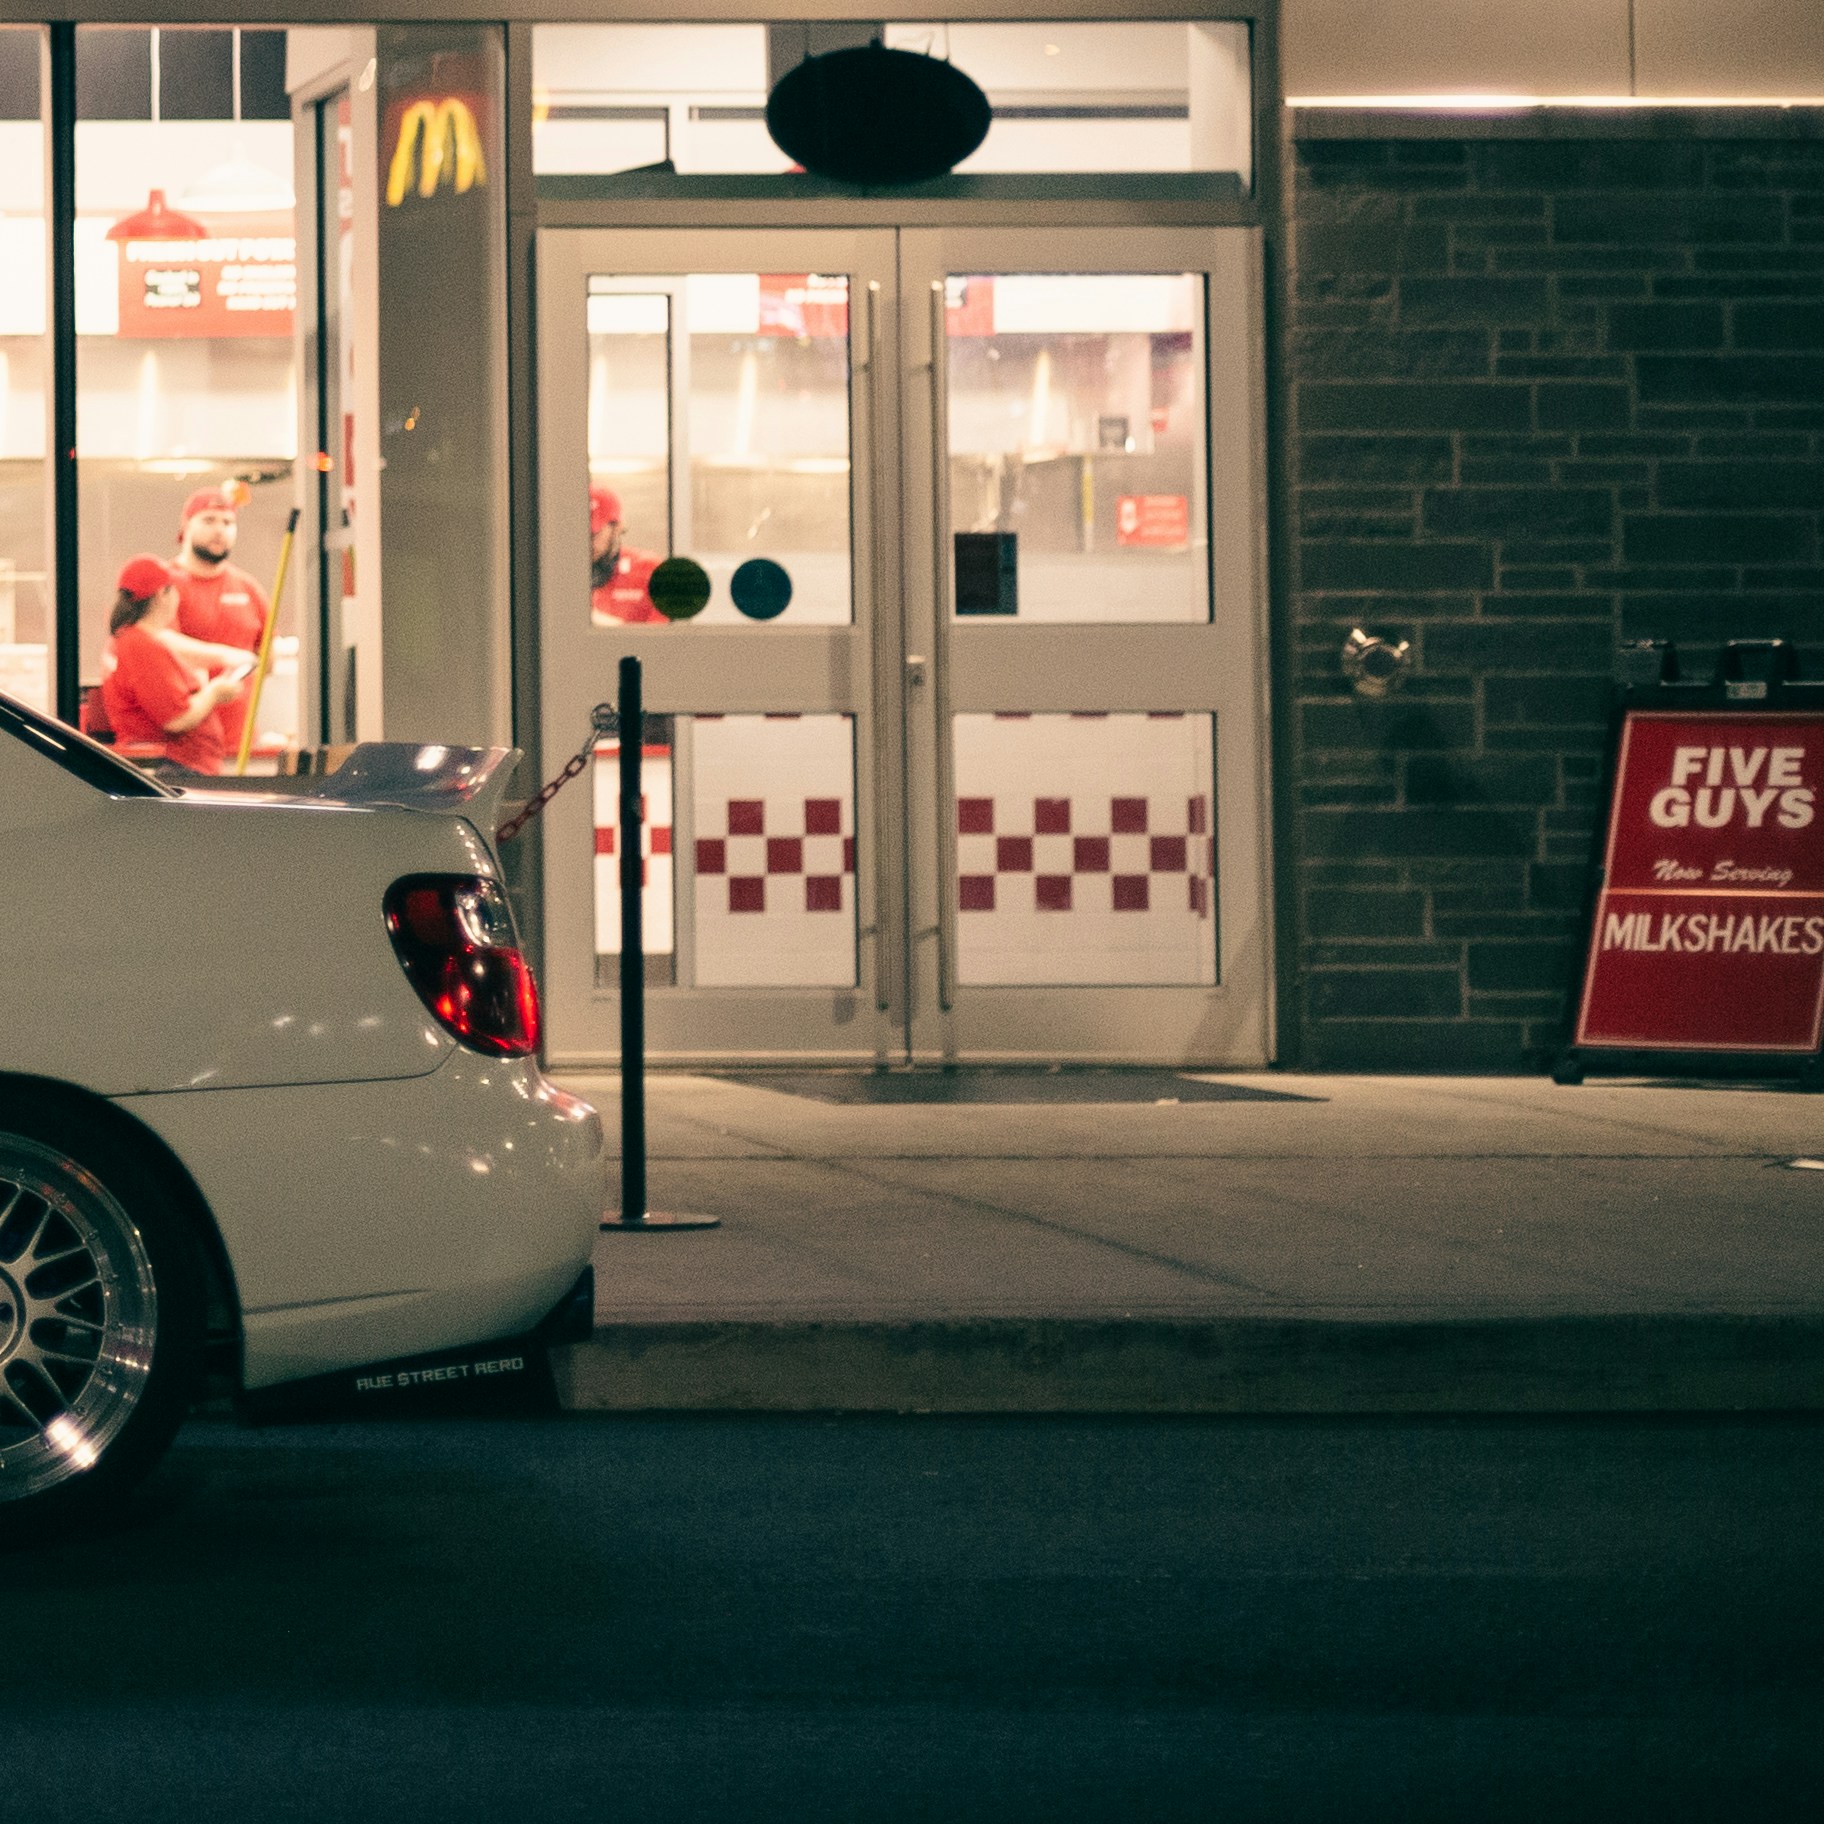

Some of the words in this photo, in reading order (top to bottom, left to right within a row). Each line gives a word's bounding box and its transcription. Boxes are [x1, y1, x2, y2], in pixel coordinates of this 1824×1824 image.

[1670, 746, 1806, 787] FIVE
[1648, 786, 1816, 828] GUYS
[1653, 858, 1704, 881] Now
[1710, 859, 1793, 887] Serving
[1603, 912, 1824, 954] MILKSHAKES
[397, 1364, 469, 1388] STREET
